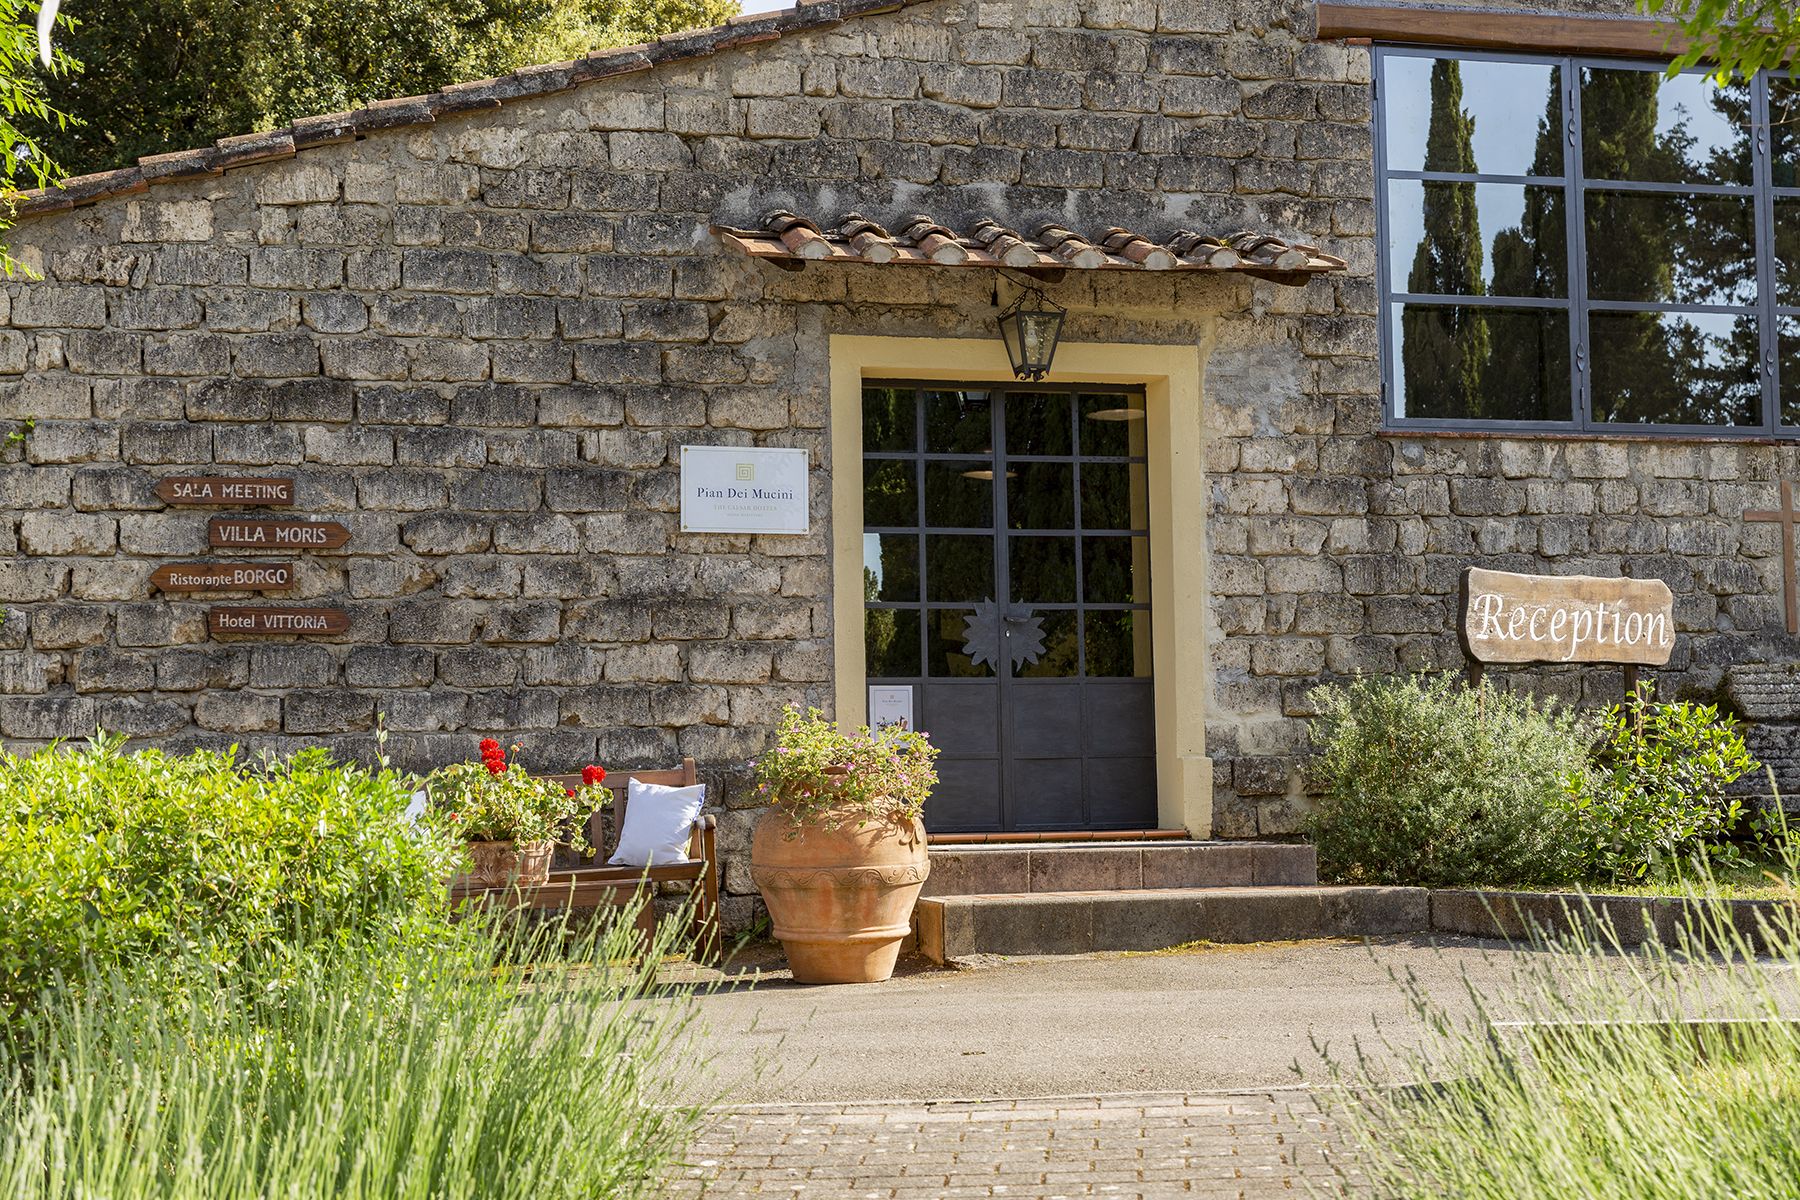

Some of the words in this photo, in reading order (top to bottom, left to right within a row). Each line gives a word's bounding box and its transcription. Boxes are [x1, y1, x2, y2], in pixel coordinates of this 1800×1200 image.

[173, 483, 213, 498] SALA
[222, 484, 288, 499] MEETING
[696, 487, 723, 498] Pian
[728, 488, 748, 499] Dei
[751, 488, 793, 500] Mucini
[219, 526, 265, 542] VILLA
[275, 527, 327, 543] MORIS
[170, 573, 232, 586] Ristorante
[233, 569, 288, 584] BORGO
[219, 613, 255, 628] Hotel
[263, 614, 328, 629] VITTORIA
[1473, 593, 1670, 661] Reception
